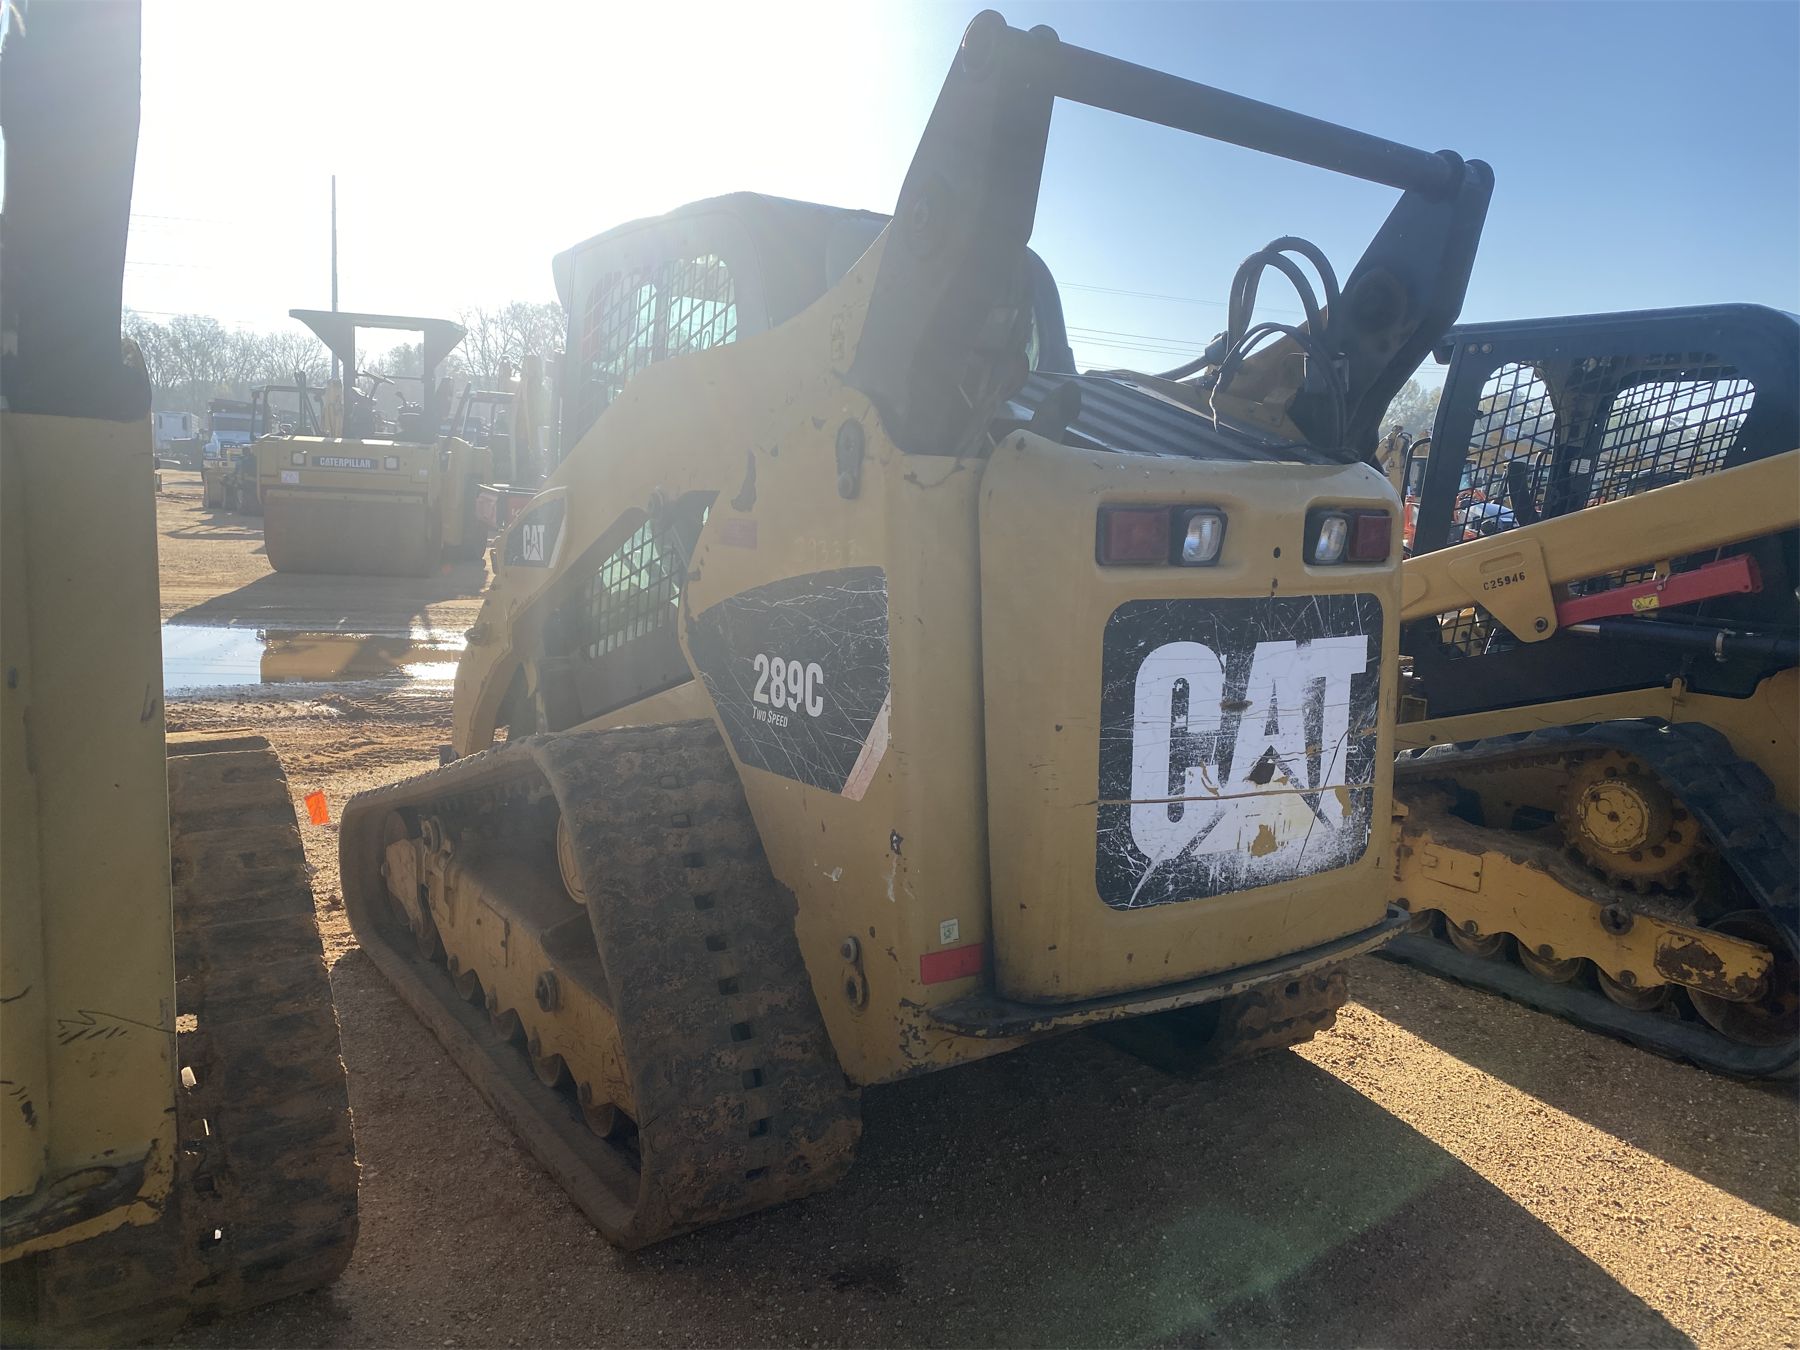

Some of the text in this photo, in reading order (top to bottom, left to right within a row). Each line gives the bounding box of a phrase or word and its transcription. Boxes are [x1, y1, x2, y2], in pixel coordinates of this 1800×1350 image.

[320, 457, 370, 468] CATERPILLAR
[523, 524, 545, 560] CAT
[1483, 571, 1526, 591] C25946
[753, 653, 824, 718] 289C
[1130, 634, 1368, 863] CAT
